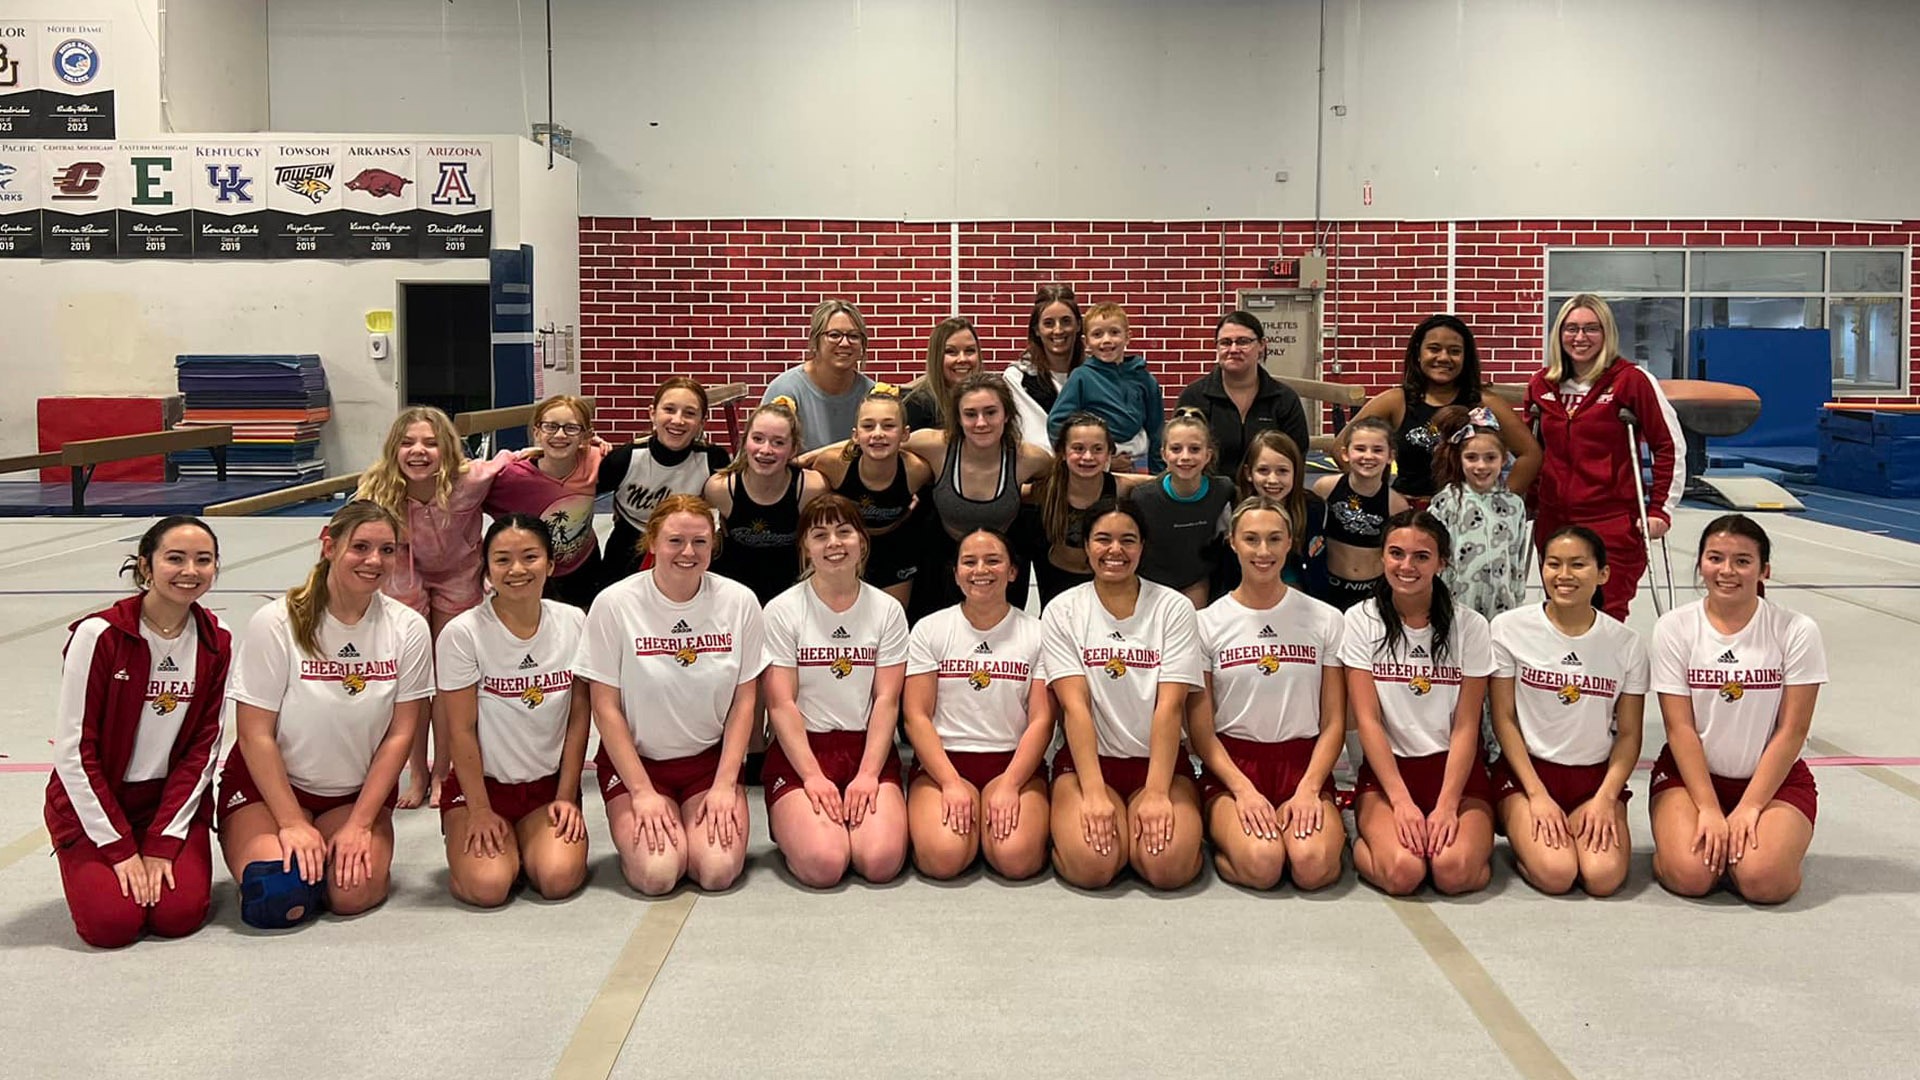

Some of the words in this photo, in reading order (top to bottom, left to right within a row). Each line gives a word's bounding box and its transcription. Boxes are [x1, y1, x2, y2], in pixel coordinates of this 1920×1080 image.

[67, 123, 88, 131] 2023
[196, 147, 261, 157] KENTUCKY
[279, 146, 330, 156] TOWSON
[348, 147, 411, 156] ARKANSAS
[427, 147, 482, 156] ARIZONA
[274, 163, 335, 186] TOWSON
[131, 157, 173, 205] E
[205, 164, 253, 203] UK
[431, 162, 476, 205] A
[70, 242, 90, 251] 2019
[146, 242, 166, 251] 2019
[220, 242, 240, 251] 2019
[296, 242, 316, 251] 2019
[371, 242, 391, 251] 2019
[445, 242, 465, 251] 2019
[1274, 261, 1292, 275] EXIT
[1344, 581, 1377, 591] NIK
[635, 633, 732, 650] CHEERLEADING
[797, 647, 877, 660] HEERLEADI
[1219, 644, 1317, 663] CHEERLEADING
[301, 659, 397, 676] CHEERLEADIN
[1372, 662, 1462, 679] CHEERLEADING
[484, 670, 572, 691] CHEERLEADIN
[1687, 669, 1783, 683] HEERLEADING
